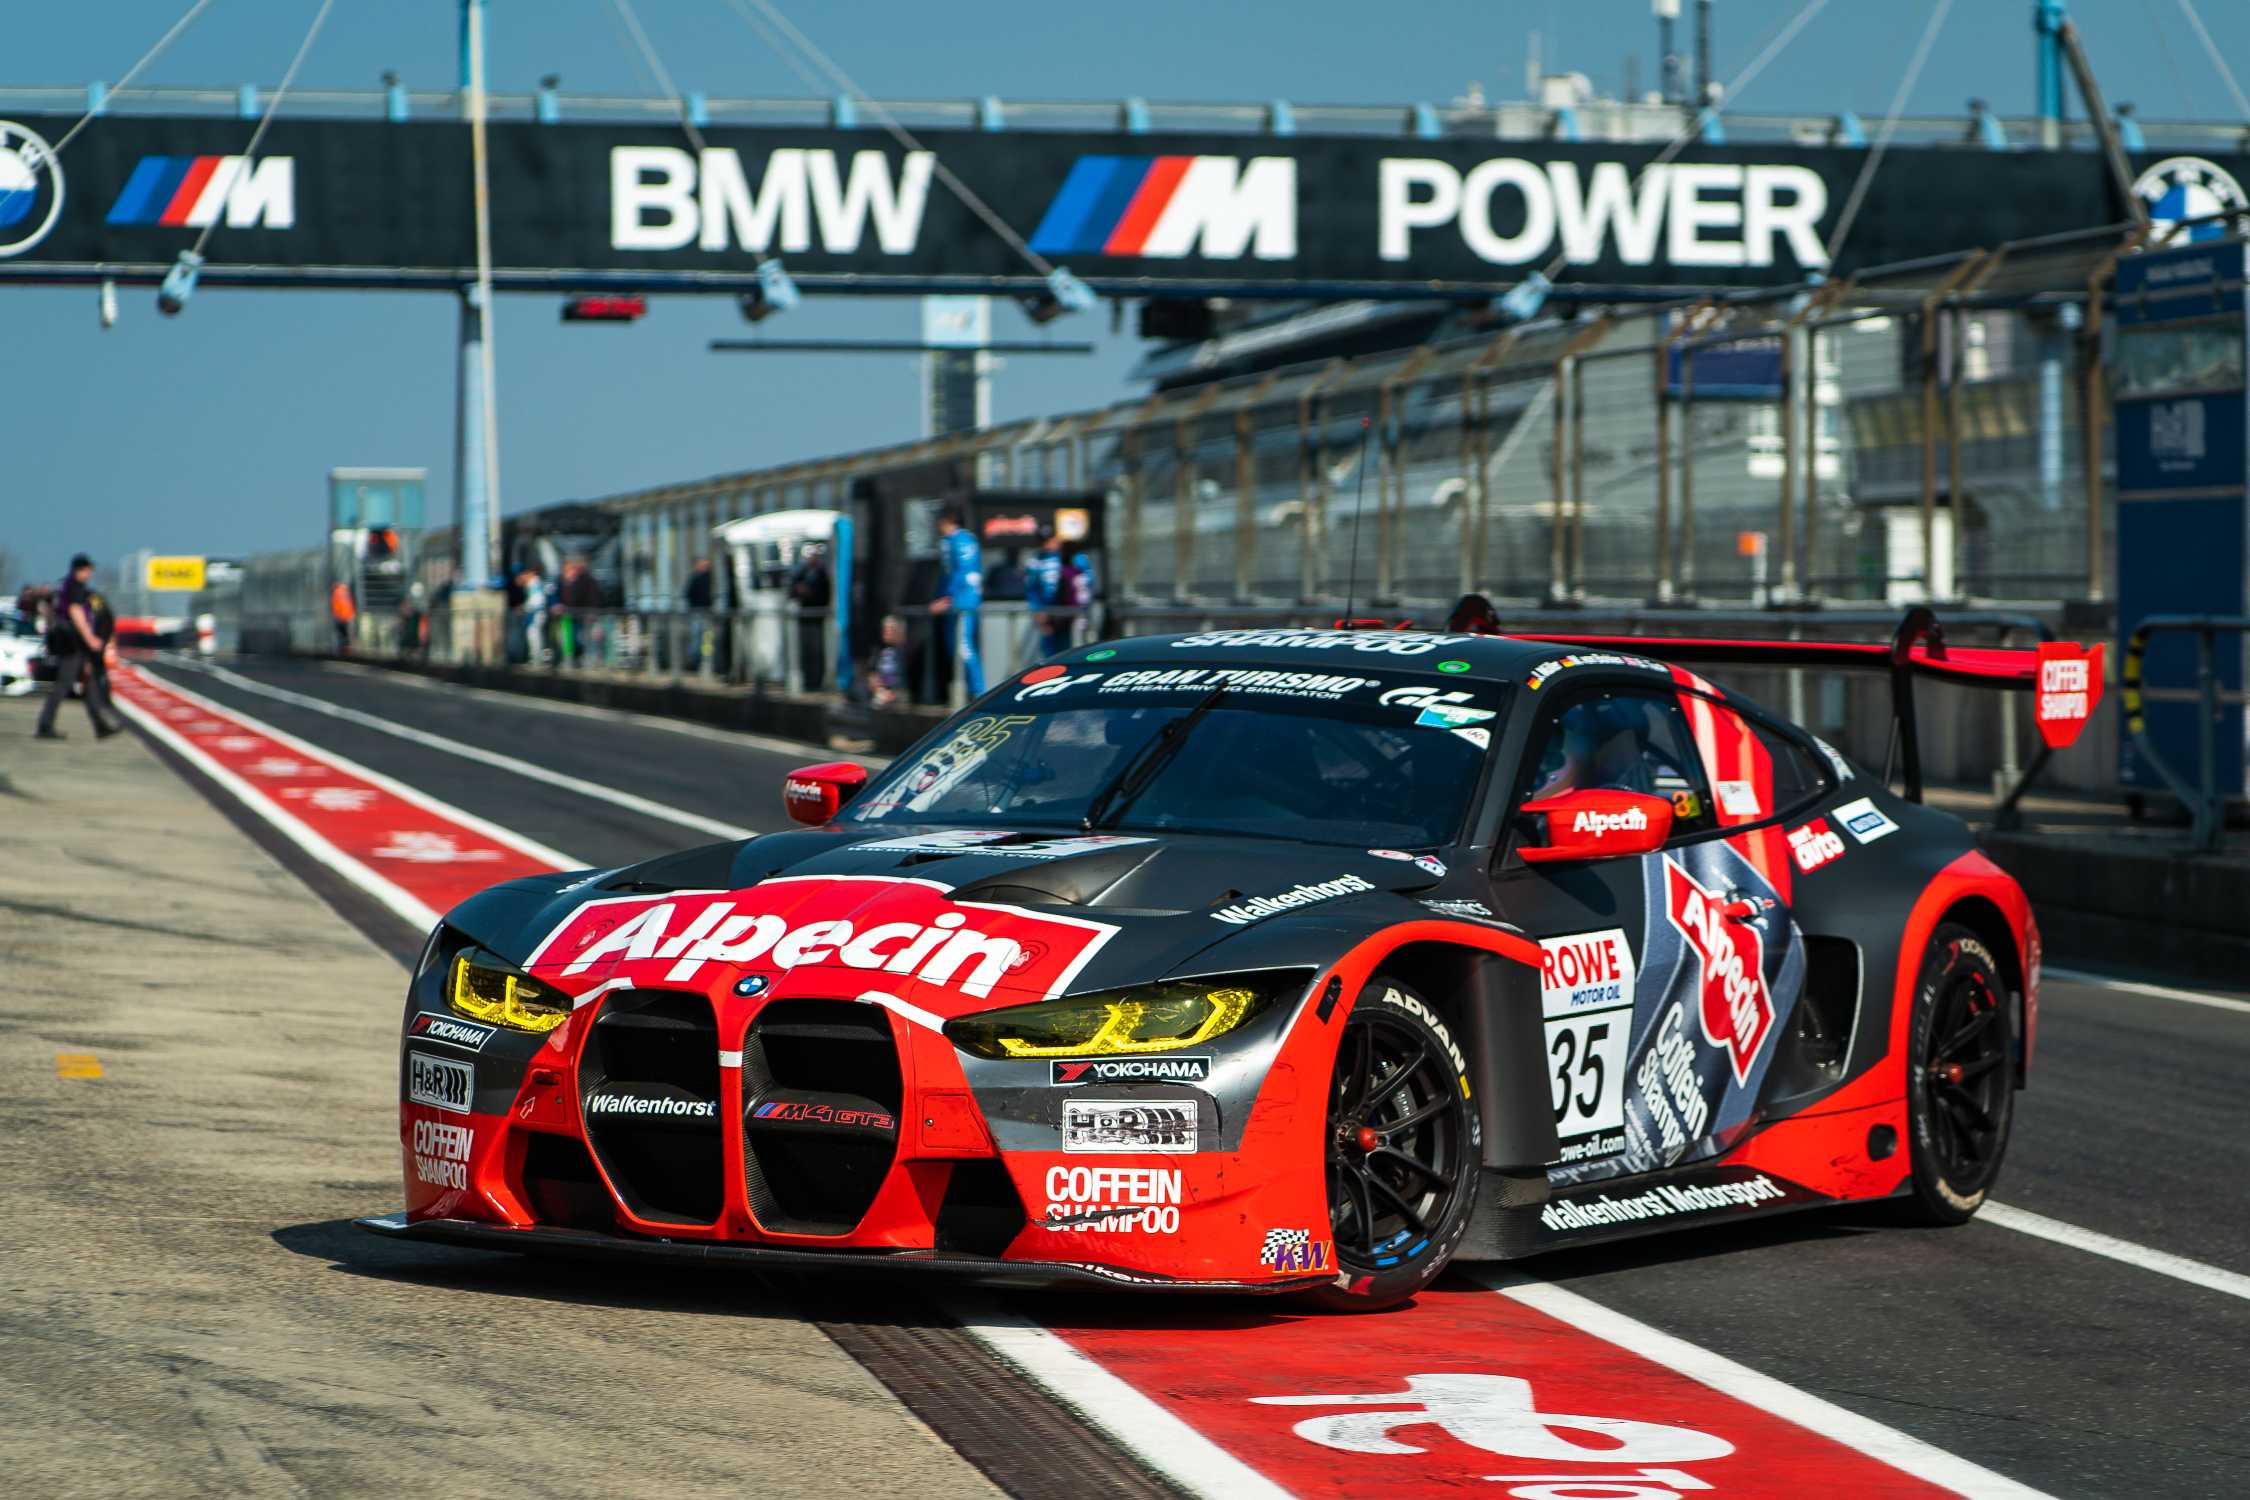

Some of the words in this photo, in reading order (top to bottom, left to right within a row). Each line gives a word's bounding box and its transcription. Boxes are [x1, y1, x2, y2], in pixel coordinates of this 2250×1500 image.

[610, 145, 937, 255] BMW
[1379, 157, 1830, 268] POWER
[1171, 635, 1437, 655] SHAMPOO
[1098, 685, 1129, 694] THE
[1130, 684, 1172, 693] REAL
[1245, 686, 1343, 700] SIMULATOR
[1102, 669, 1211, 687] GRAN
[1573, 806, 1647, 837] Alpecin
[1210, 873, 1376, 925] Walkenhorst
[559, 901, 1023, 1000] Alpecin
[1541, 939, 1621, 991] ROWE
[1682, 889, 1761, 1053] Alpecin
[1571, 987, 1606, 1006] MOTOR
[1607, 984, 1621, 1001] OIL
[427, 1019, 485, 1046] YOKOHAMA
[1382, 986, 1466, 1074] ADVAN
[1093, 1060, 1204, 1078] YOKOHAMA
[1551, 1022, 1610, 1125] 35
[1656, 1001, 1709, 1141] Coffein
[591, 1094, 717, 1117] Walkenhorst
[413, 1119, 474, 1162] COFFEIN
[1559, 1133, 1625, 1162] owe-oil.com
[415, 1154, 467, 1191] SHAMPOO
[1045, 1166, 1182, 1203] COFFEIN
[1540, 1190, 1672, 1231] Walkenhorst
[1654, 1174, 1786, 1214] Motorsport
[1273, 1240, 1332, 1273] KW
